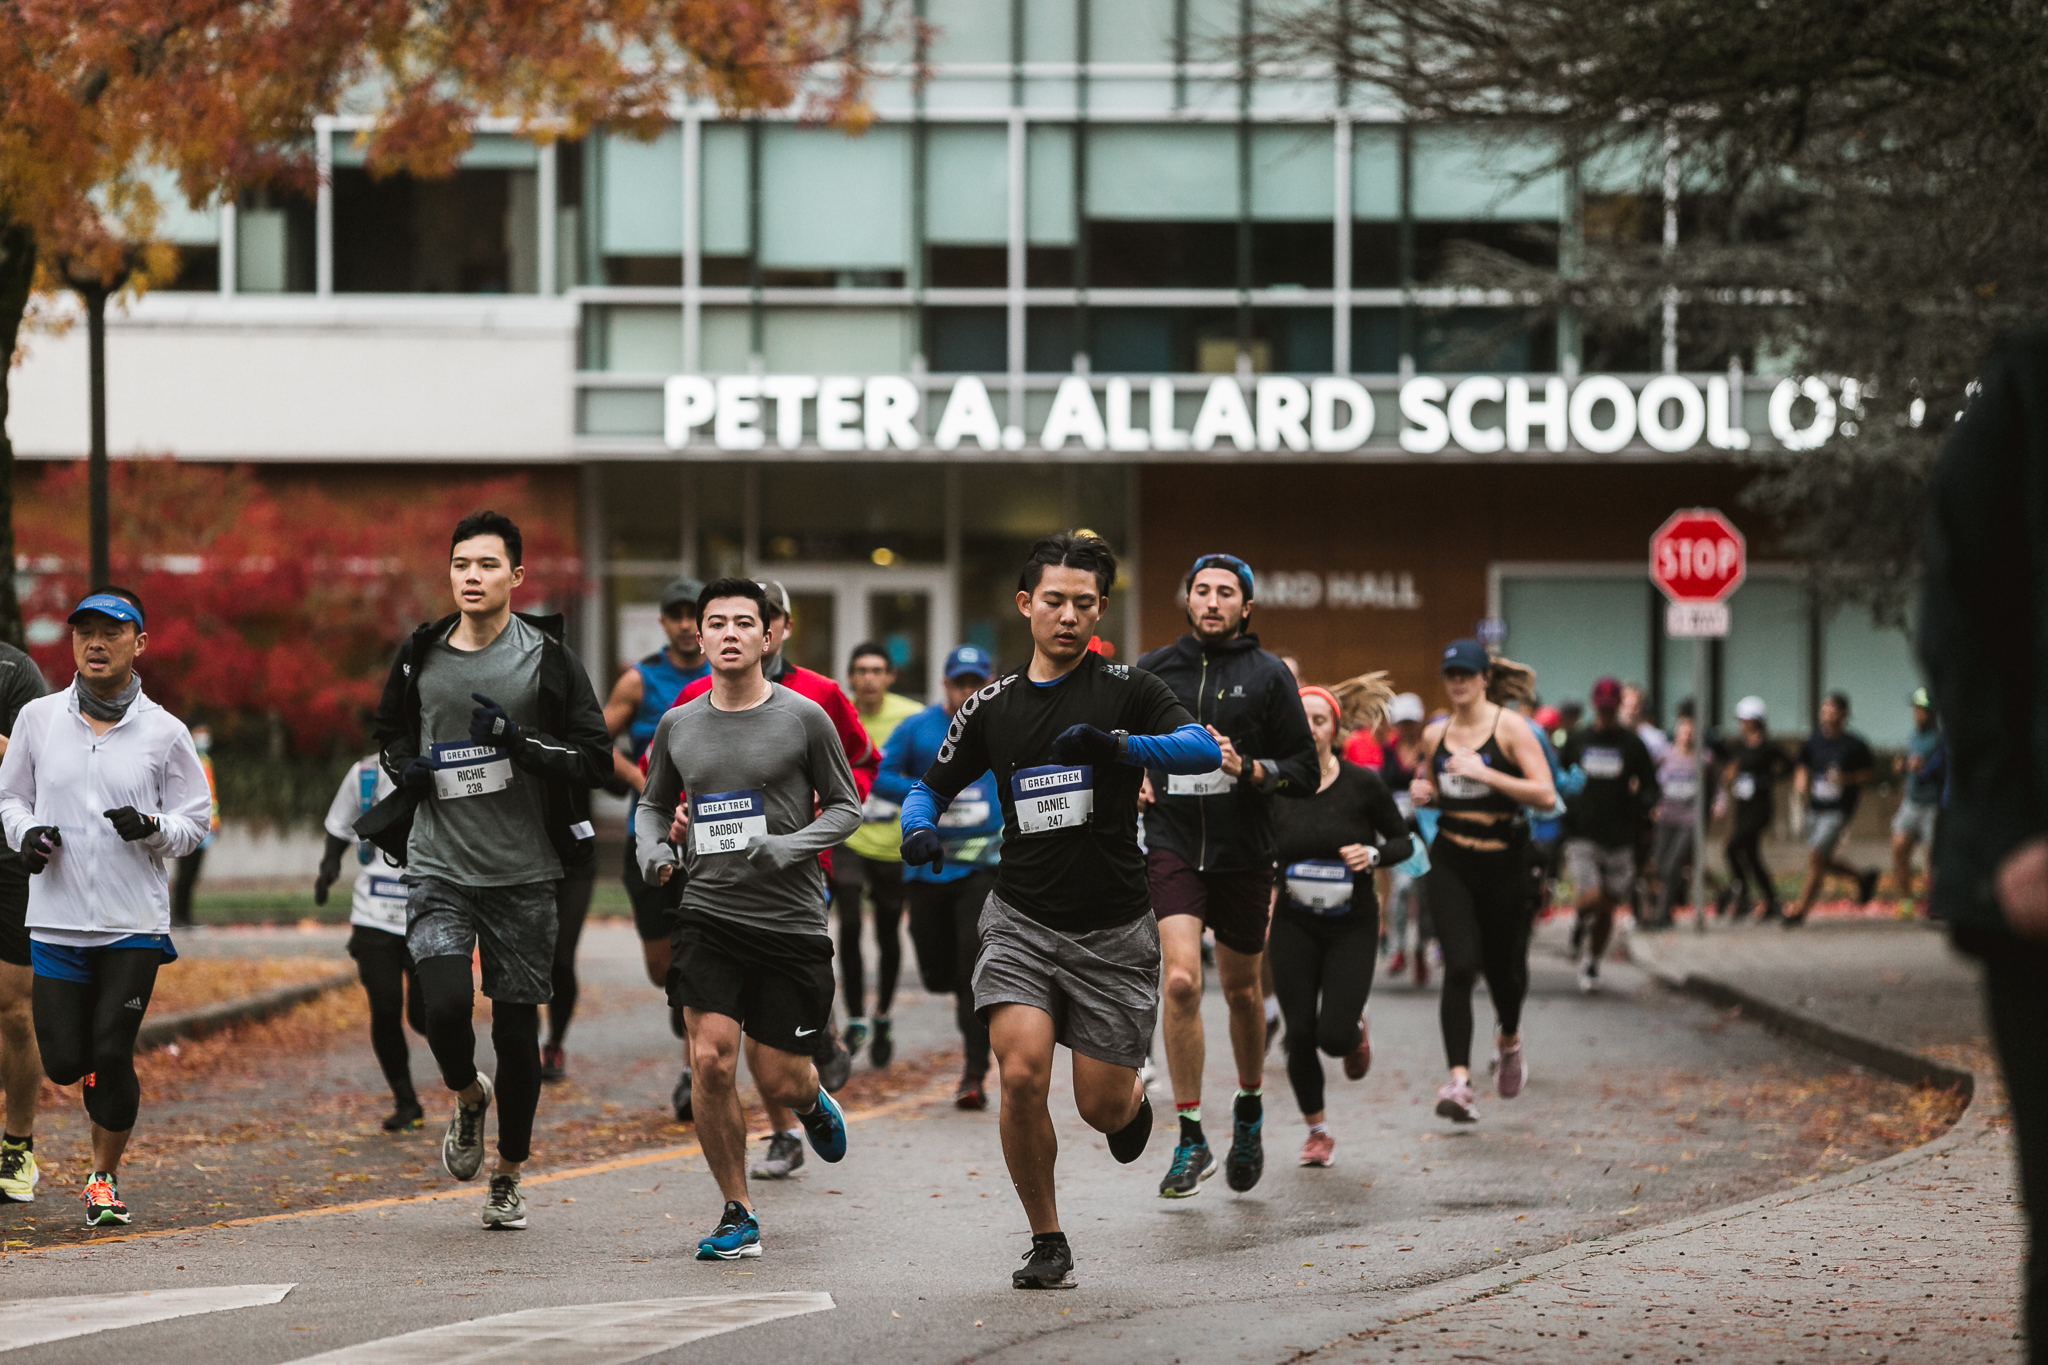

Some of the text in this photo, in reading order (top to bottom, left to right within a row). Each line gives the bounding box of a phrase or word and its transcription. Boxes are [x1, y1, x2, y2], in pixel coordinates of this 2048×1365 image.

[663, 375, 922, 451] PETER
[936, 375, 1025, 451] A.
[1041, 375, 1374, 451] ALLARD
[1400, 375, 1750, 452] SCHOOL
[1659, 537, 1737, 580] STOP
[1327, 571, 1423, 610] HALL
[937, 674, 1019, 764] adidas
[447, 750, 471, 760] GREAT
[457, 767, 487, 782] RICHIE
[1028, 772, 1080, 788] GREAT TREK
[466, 782, 483, 794] 238
[703, 800, 750, 813] GREAT TREK
[1037, 796, 1070, 814] DANIEL
[1047, 814, 1063, 827] 247
[709, 822, 743, 837] BADBOY
[720, 838, 736, 850] 505
